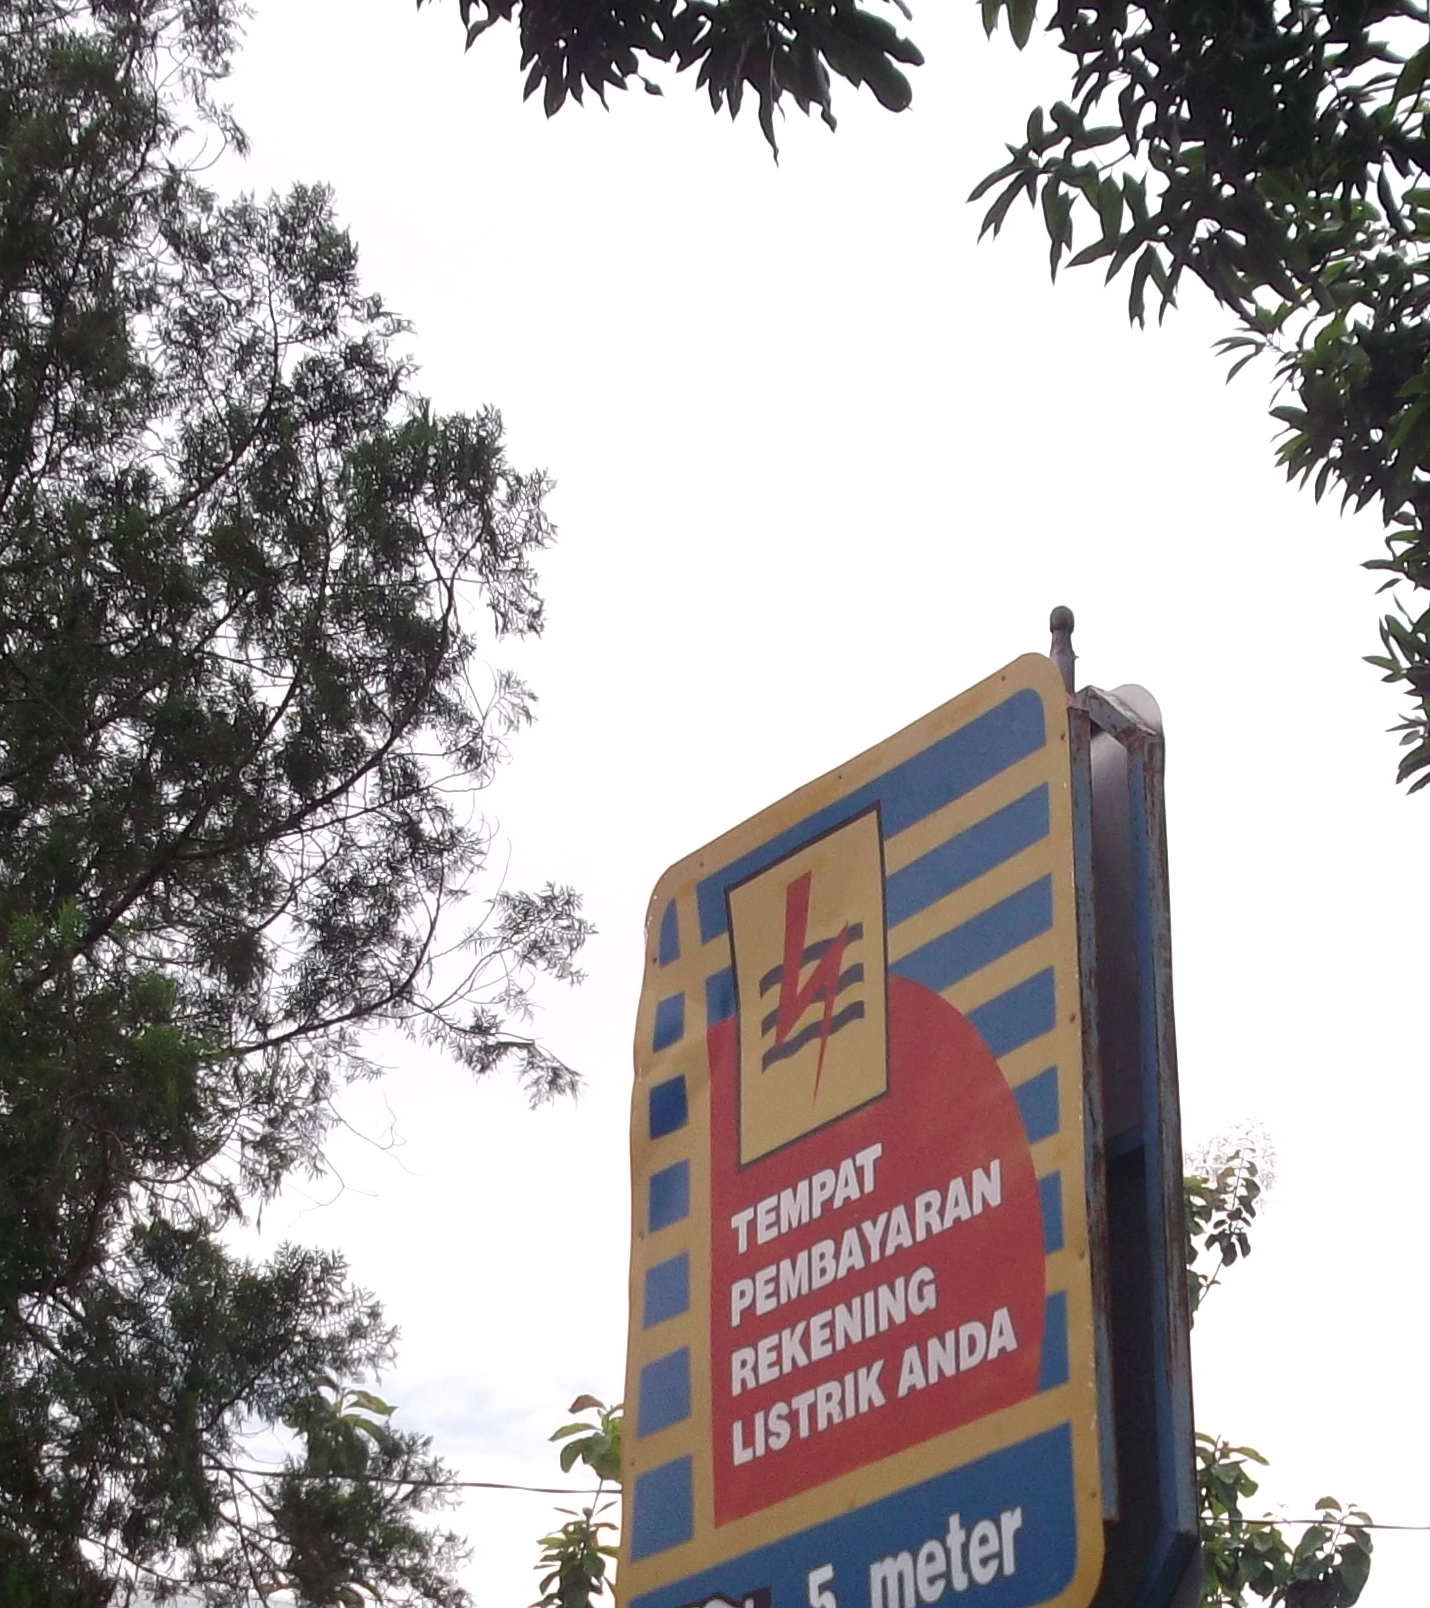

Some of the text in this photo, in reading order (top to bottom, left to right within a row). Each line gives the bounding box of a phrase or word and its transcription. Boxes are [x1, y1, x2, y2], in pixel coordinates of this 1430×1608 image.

[730, 1142, 883, 1255] TEMPAT
[730, 1158, 1002, 1328] PEMBAYARAN
[730, 1265, 937, 1397] REKENING
[731, 1306, 1019, 1467] LISTRIK ANDA
